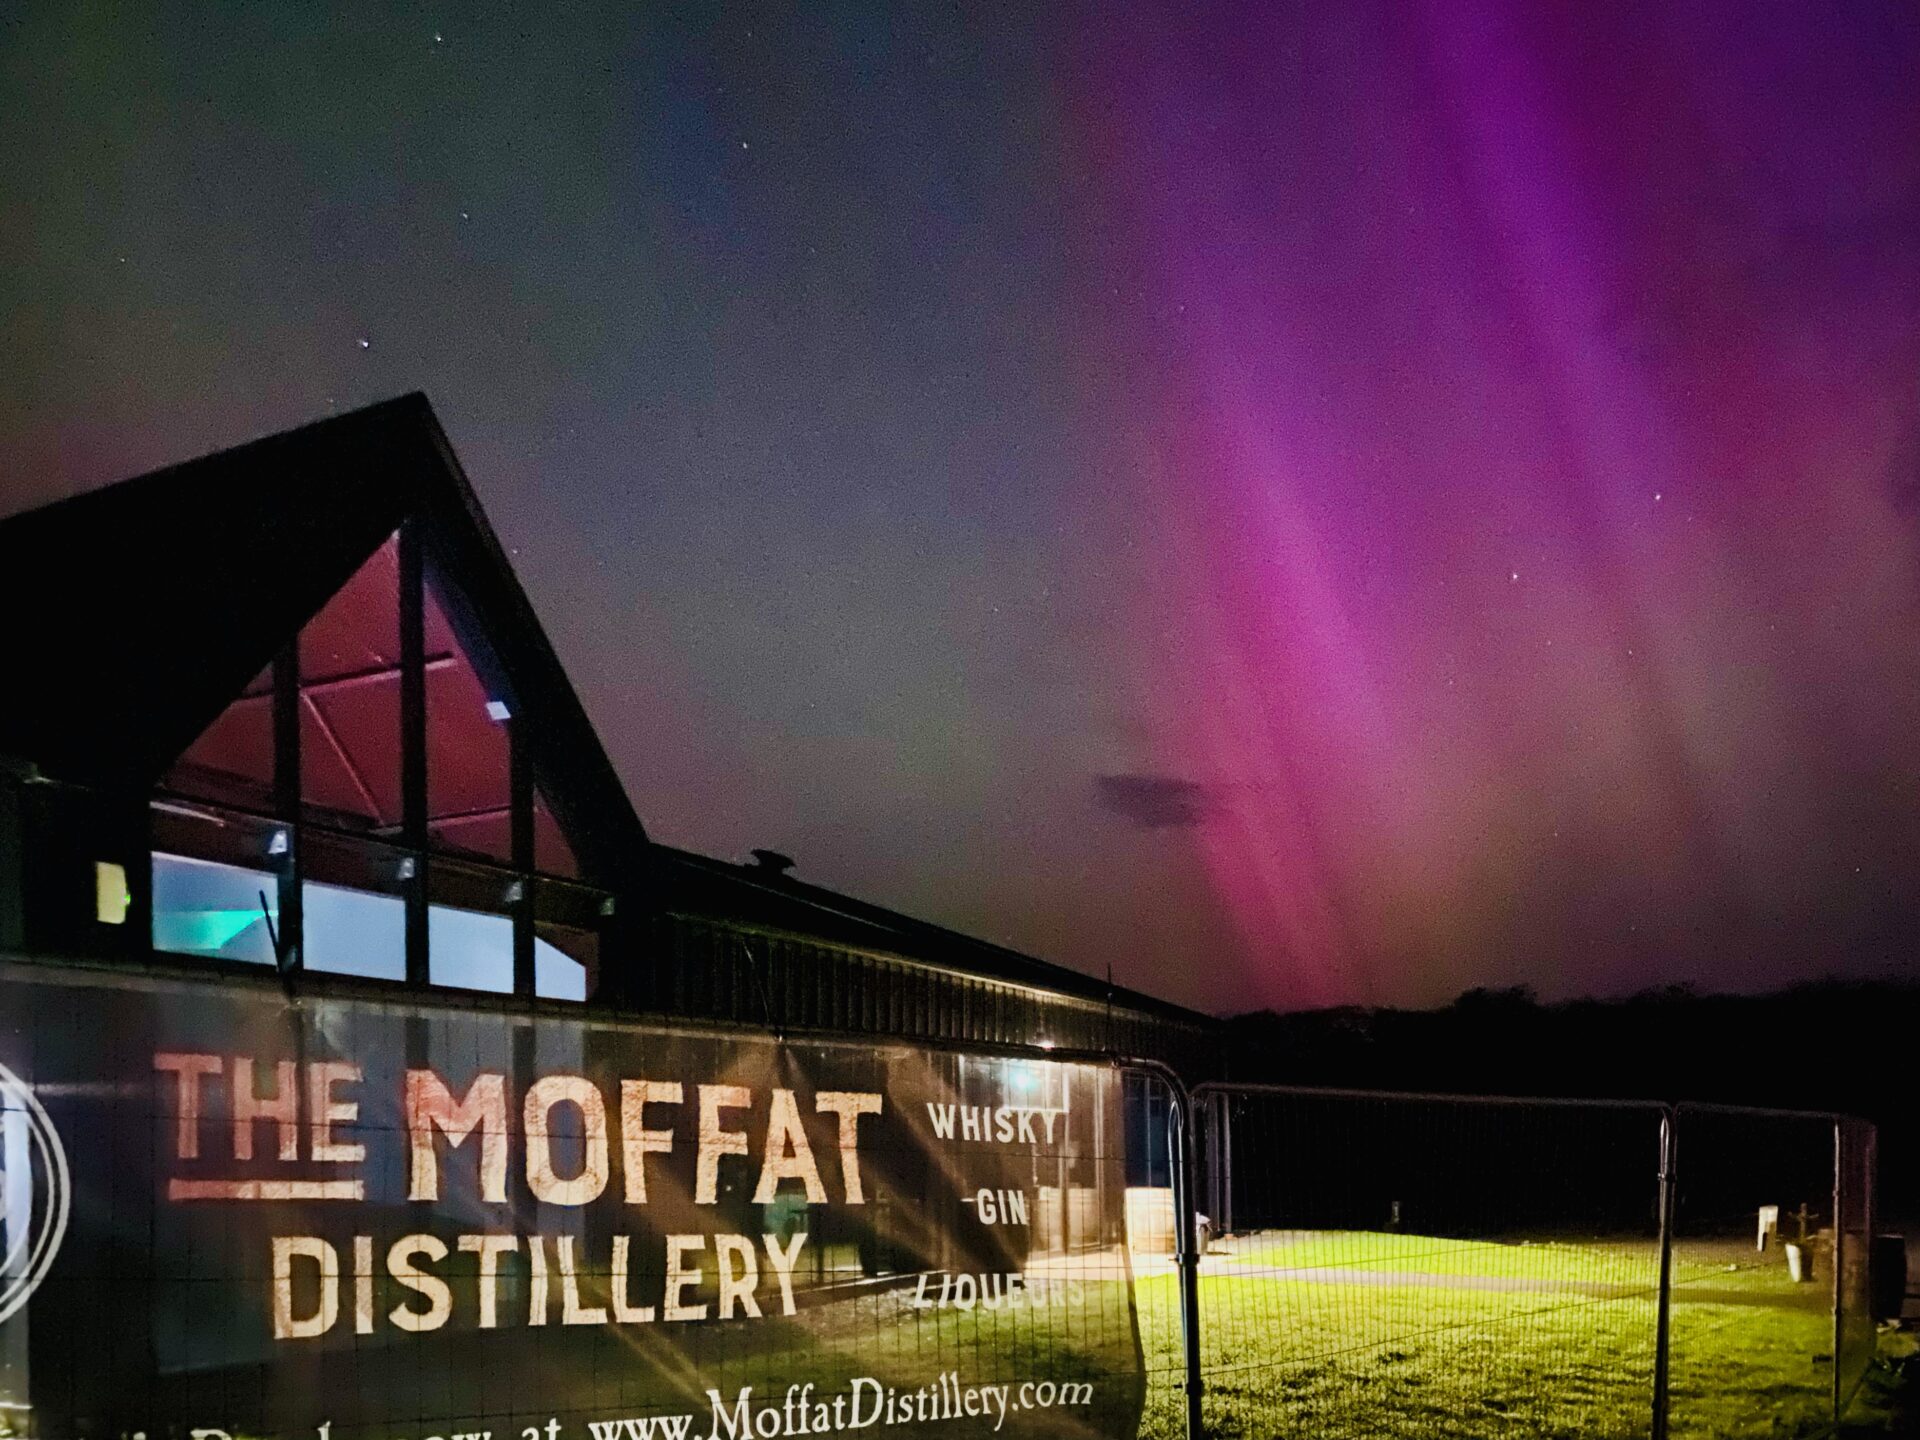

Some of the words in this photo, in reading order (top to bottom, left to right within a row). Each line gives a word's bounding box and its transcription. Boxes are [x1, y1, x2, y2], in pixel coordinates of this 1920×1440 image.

[154, 1052, 366, 1162] THE
[405, 1069, 883, 1207] MOFFAT
[926, 1102, 1057, 1144] WHISKY
[977, 1188, 1029, 1225] GIN
[272, 1232, 808, 1340] DISTILLERY
[913, 1273, 1085, 1312] LIQUEURS
[586, 1371, 1094, 1440] www.MoffatDistillery.com
